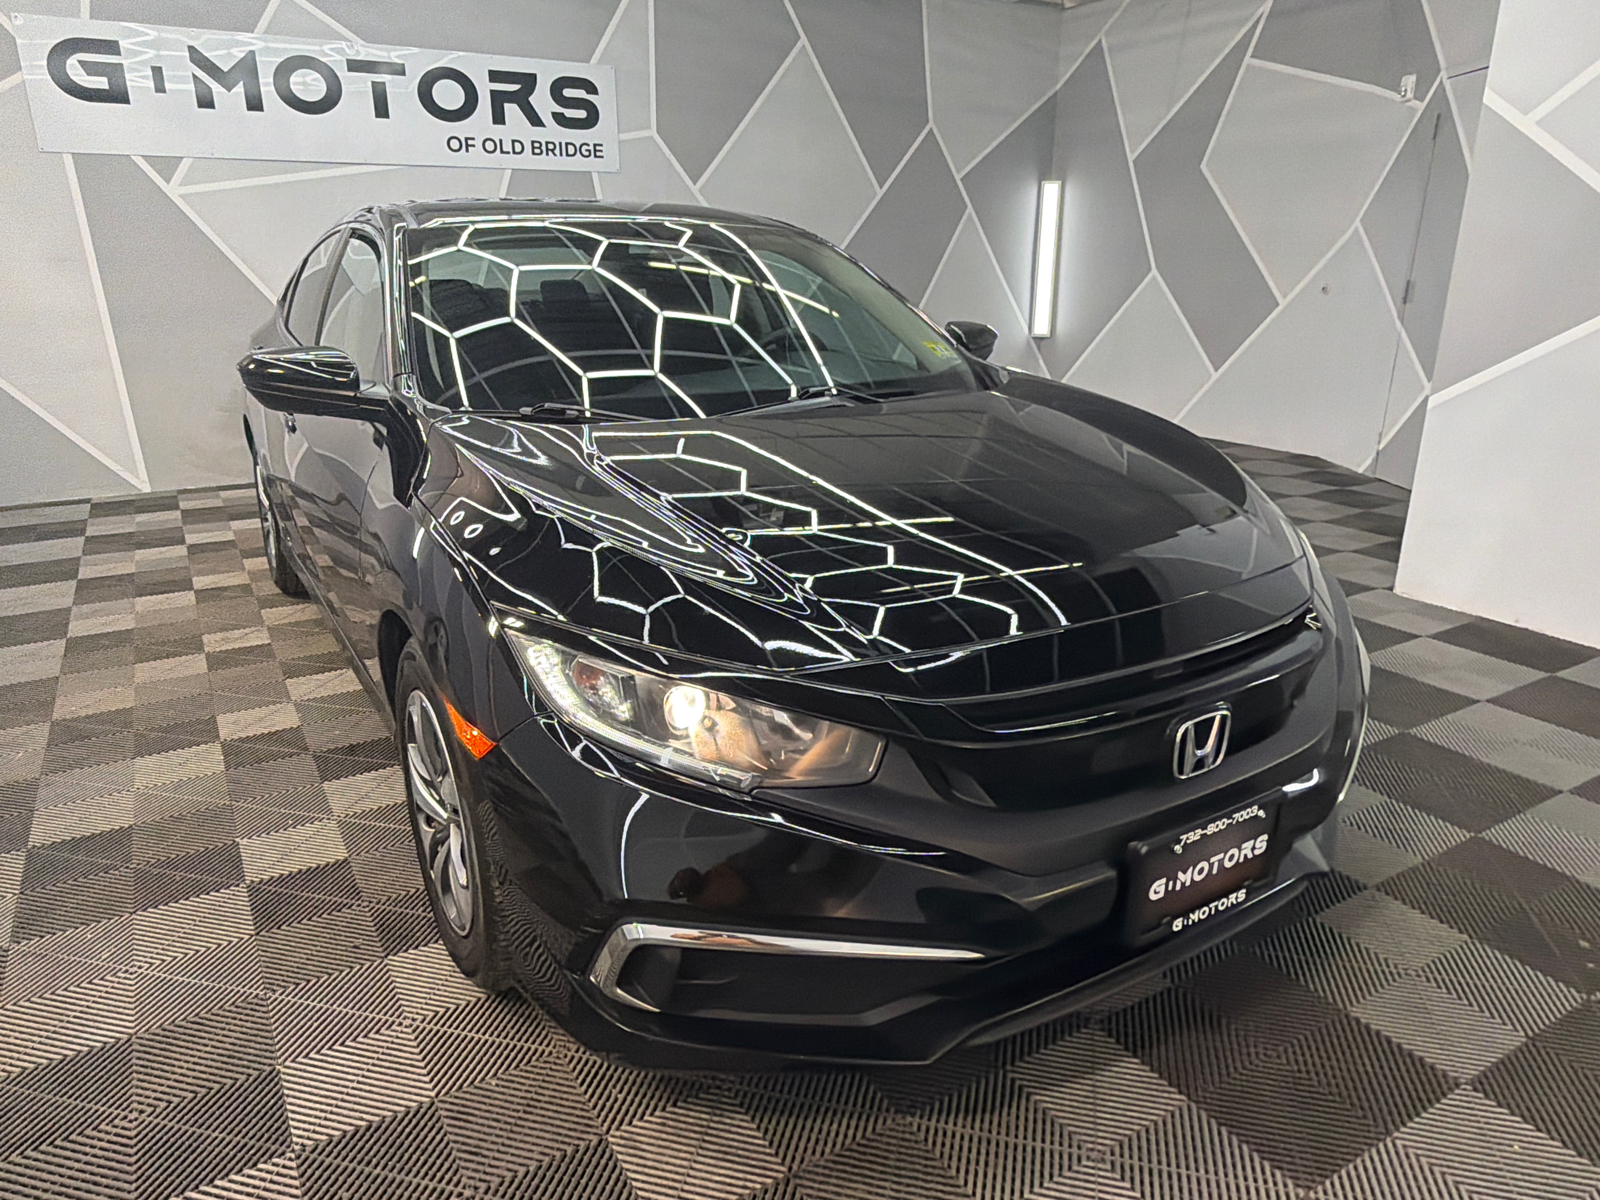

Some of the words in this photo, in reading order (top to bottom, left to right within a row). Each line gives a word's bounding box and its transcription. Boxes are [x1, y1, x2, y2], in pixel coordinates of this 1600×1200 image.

[446, 135, 476, 153] OF
[481, 137, 525, 156] OLD
[530, 139, 605, 159] BRIDGE
[1179, 805, 1259, 846] 732-800-7003
